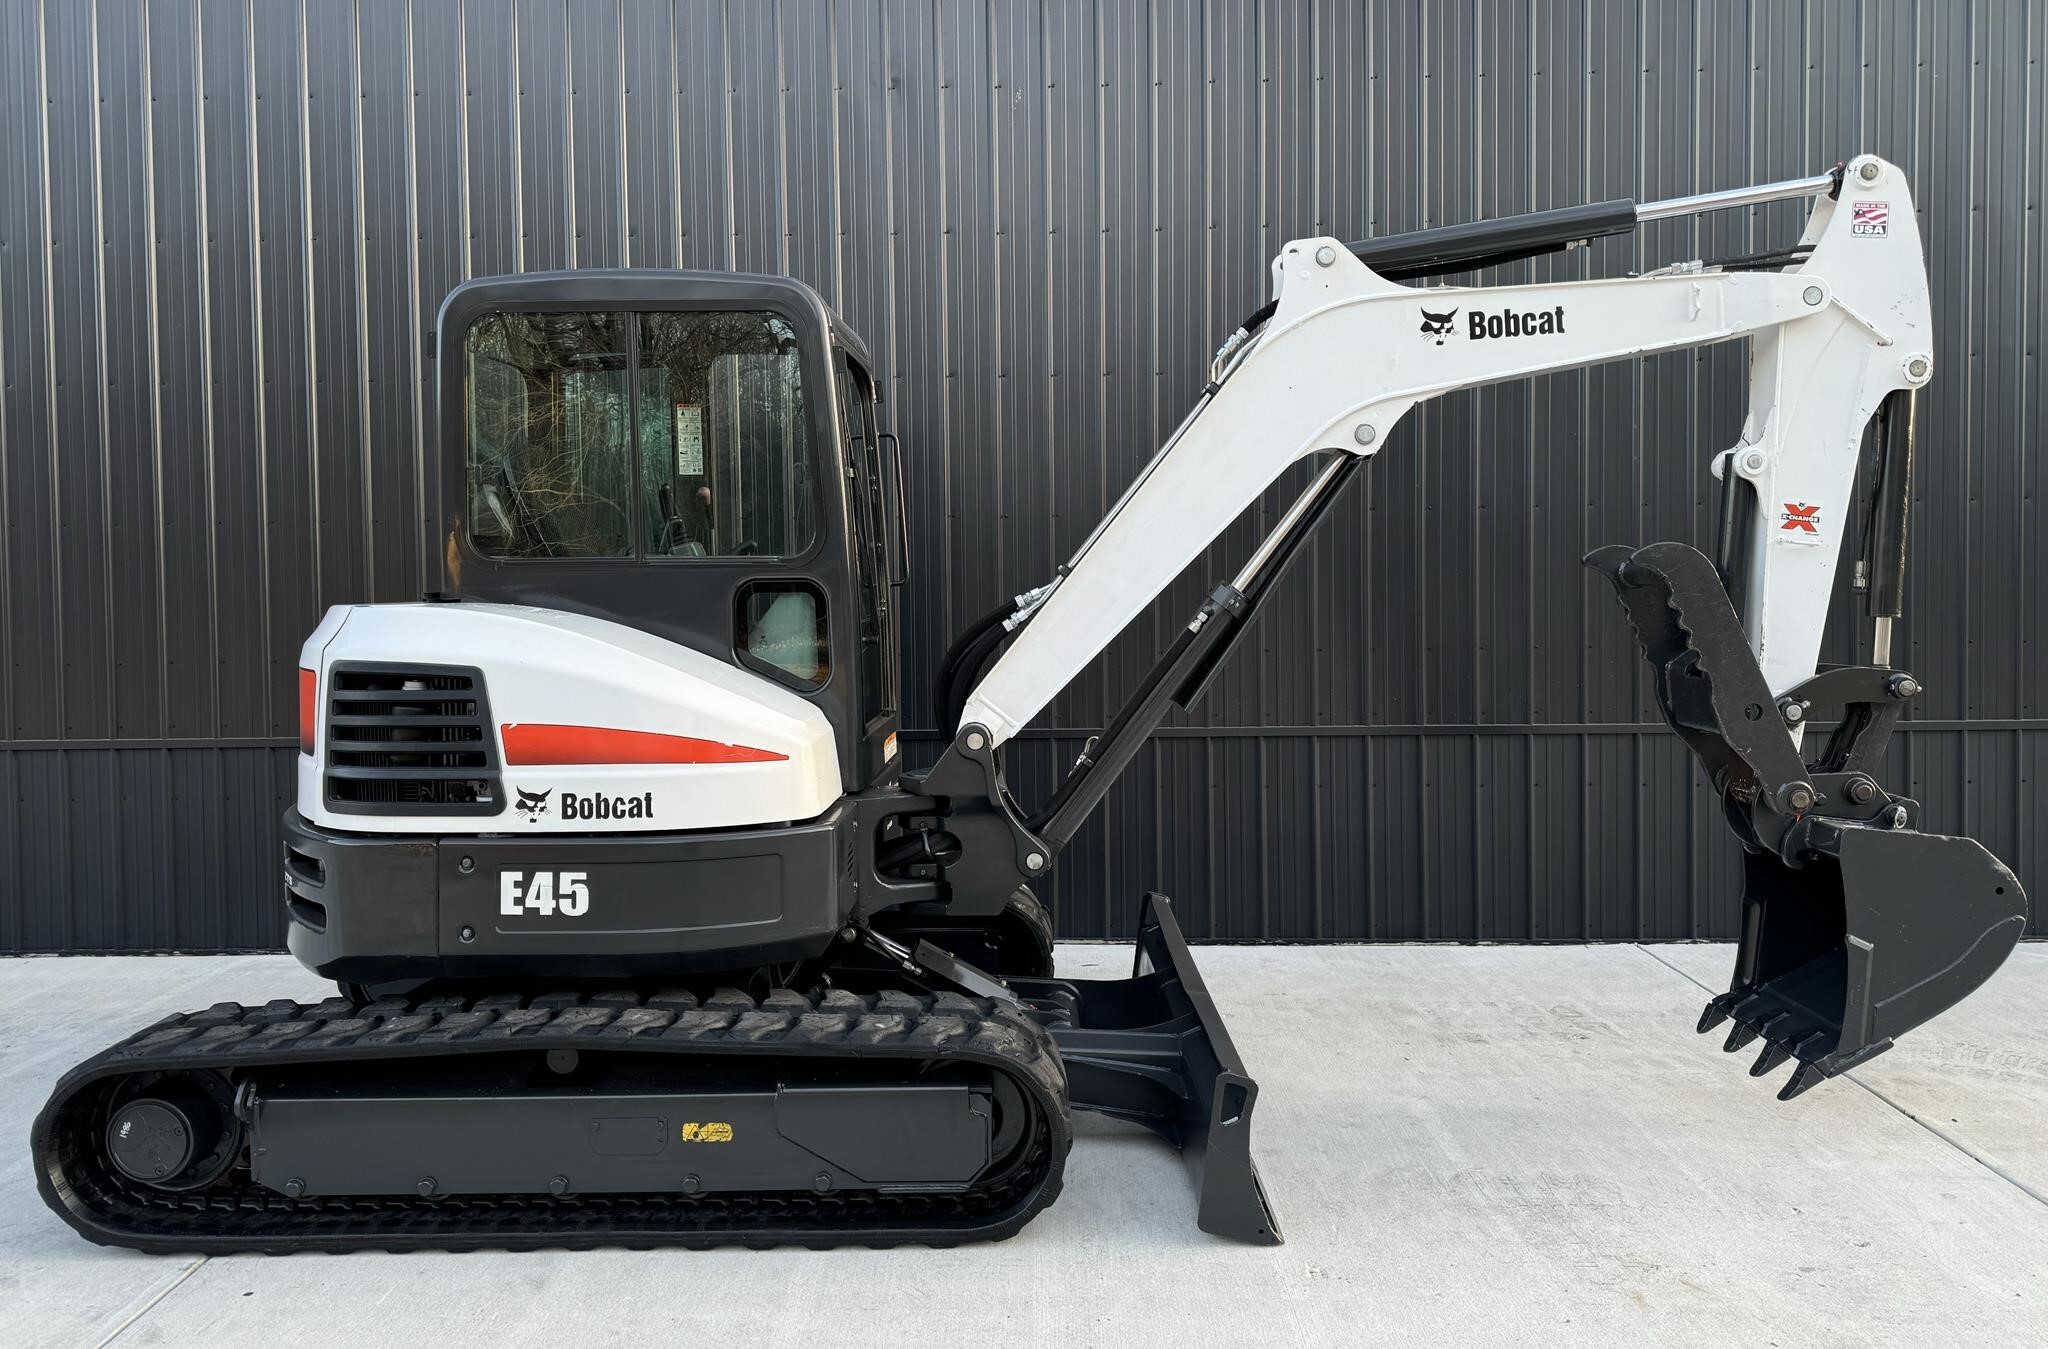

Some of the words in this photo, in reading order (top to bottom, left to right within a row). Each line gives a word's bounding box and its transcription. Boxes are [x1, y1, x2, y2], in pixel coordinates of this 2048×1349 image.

[1854, 225, 1884, 234] USA
[1468, 306, 1565, 340] Bobcat
[561, 792, 653, 820] Bobcat
[500, 871, 589, 917] E45
